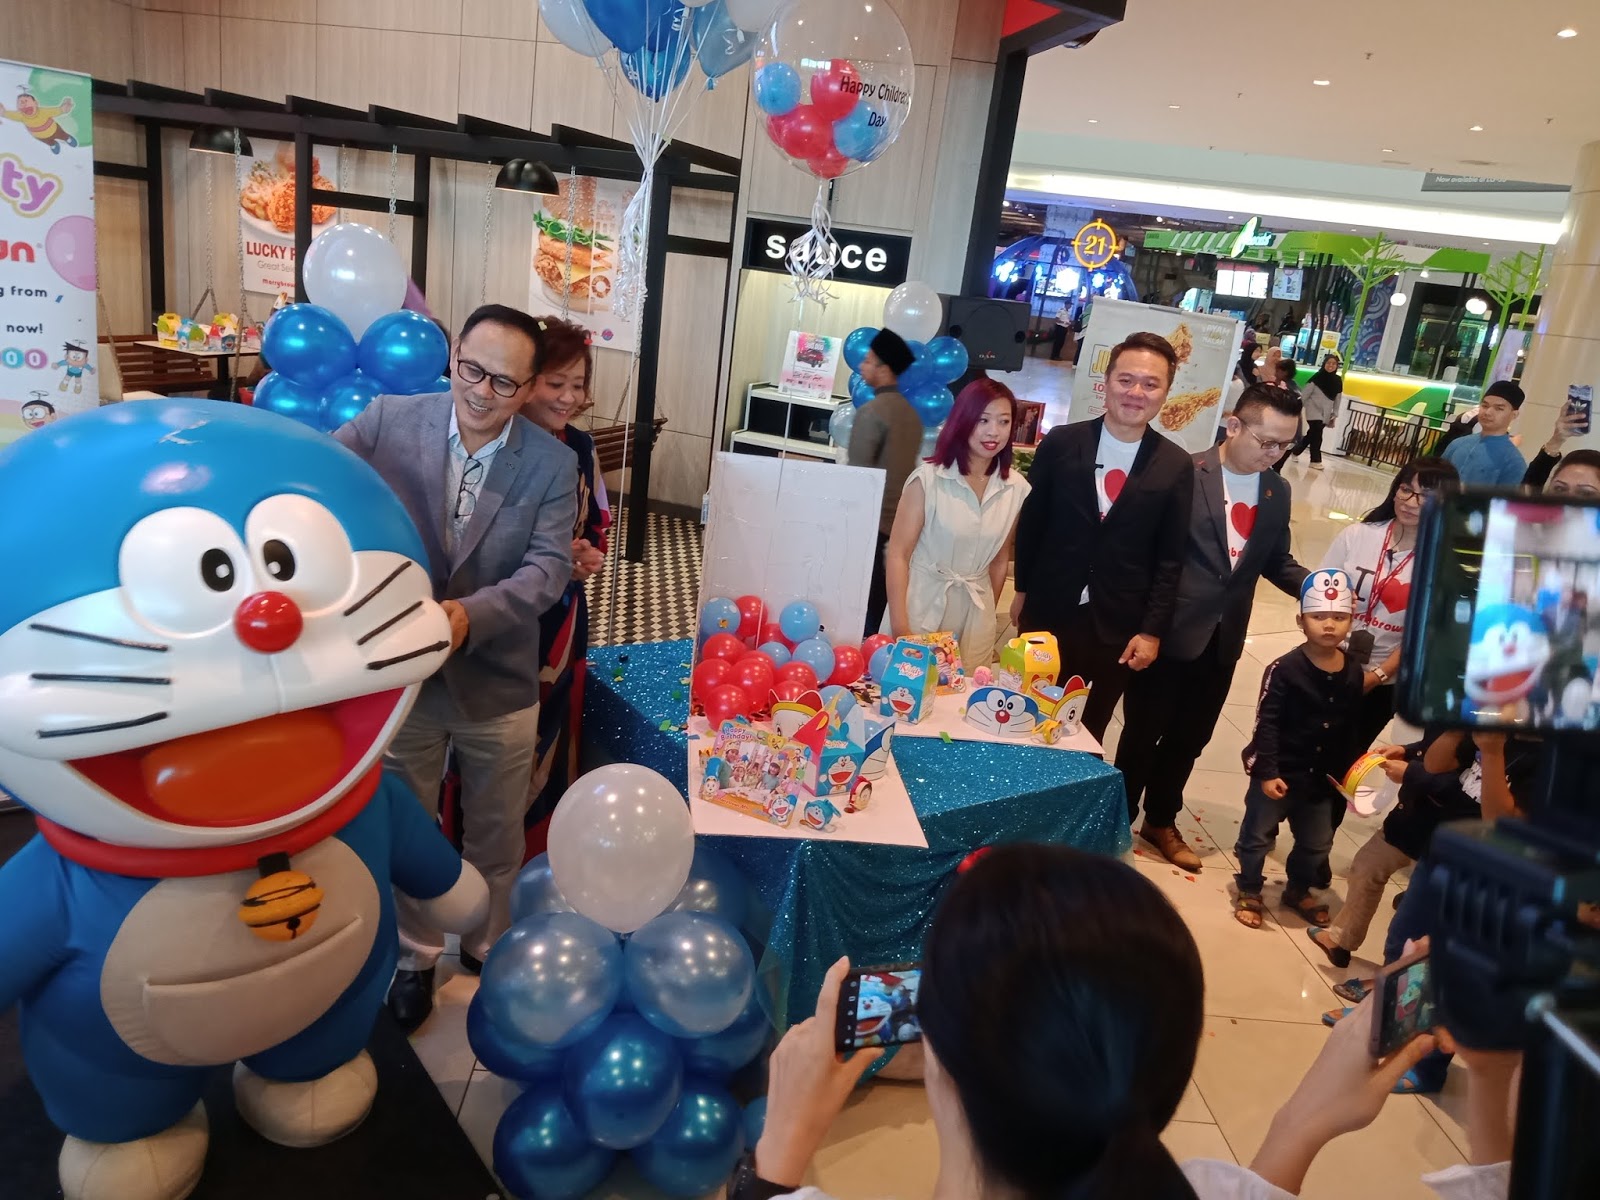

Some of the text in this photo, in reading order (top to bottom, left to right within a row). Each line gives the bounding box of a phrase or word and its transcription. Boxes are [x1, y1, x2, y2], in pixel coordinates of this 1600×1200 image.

[840, 76, 876, 97] Happy
[867, 112, 887, 127] Day
[246, 241, 287, 260] LUCKY
[765, 234, 887, 272] sauce
[1083, 235, 1105, 255] 21
[257, 260, 280, 270] Great
[11, 286, 48, 297] from
[6, 323, 43, 334] now!
[1355, 566, 1376, 602] I
